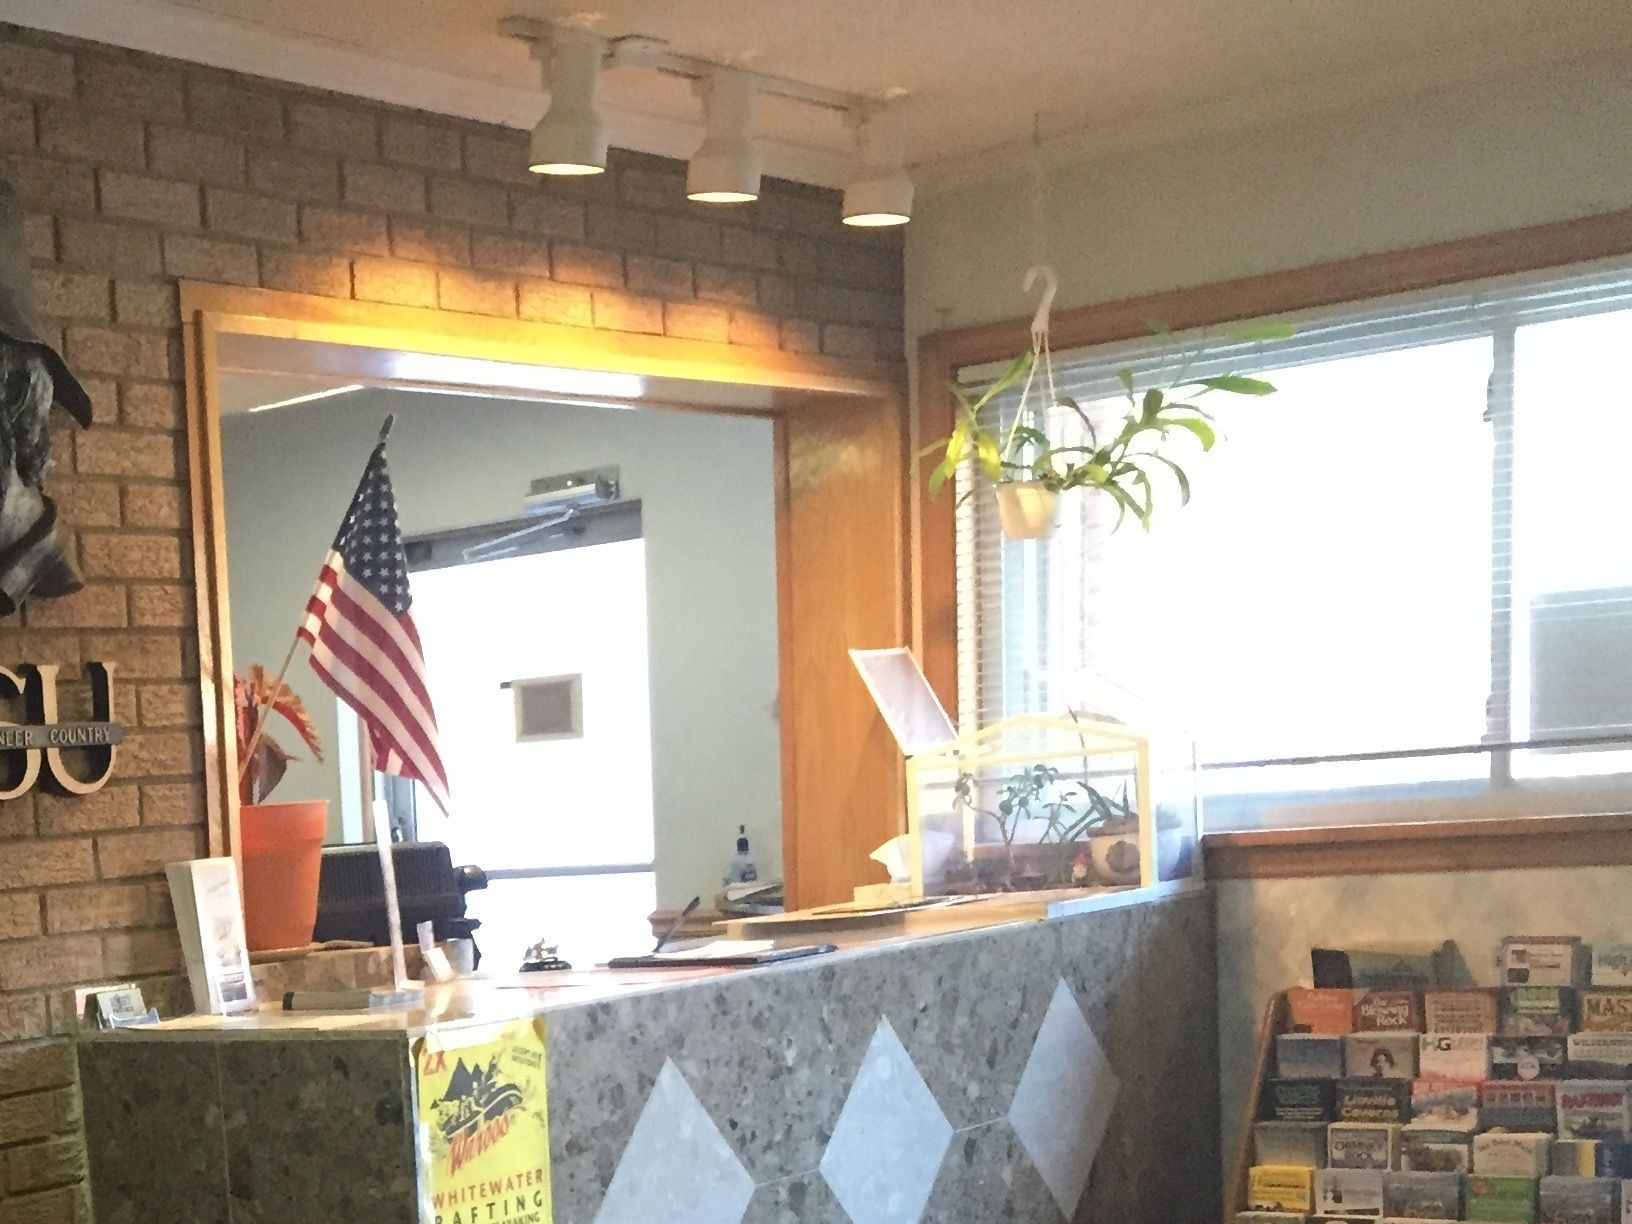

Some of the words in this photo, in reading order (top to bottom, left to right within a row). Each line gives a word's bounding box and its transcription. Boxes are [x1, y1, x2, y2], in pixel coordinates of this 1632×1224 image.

[50, 727, 112, 745] COUNTRY
[1376, 1014, 1408, 1027] Rock
[431, 1168, 543, 1210] WHITEWATER
